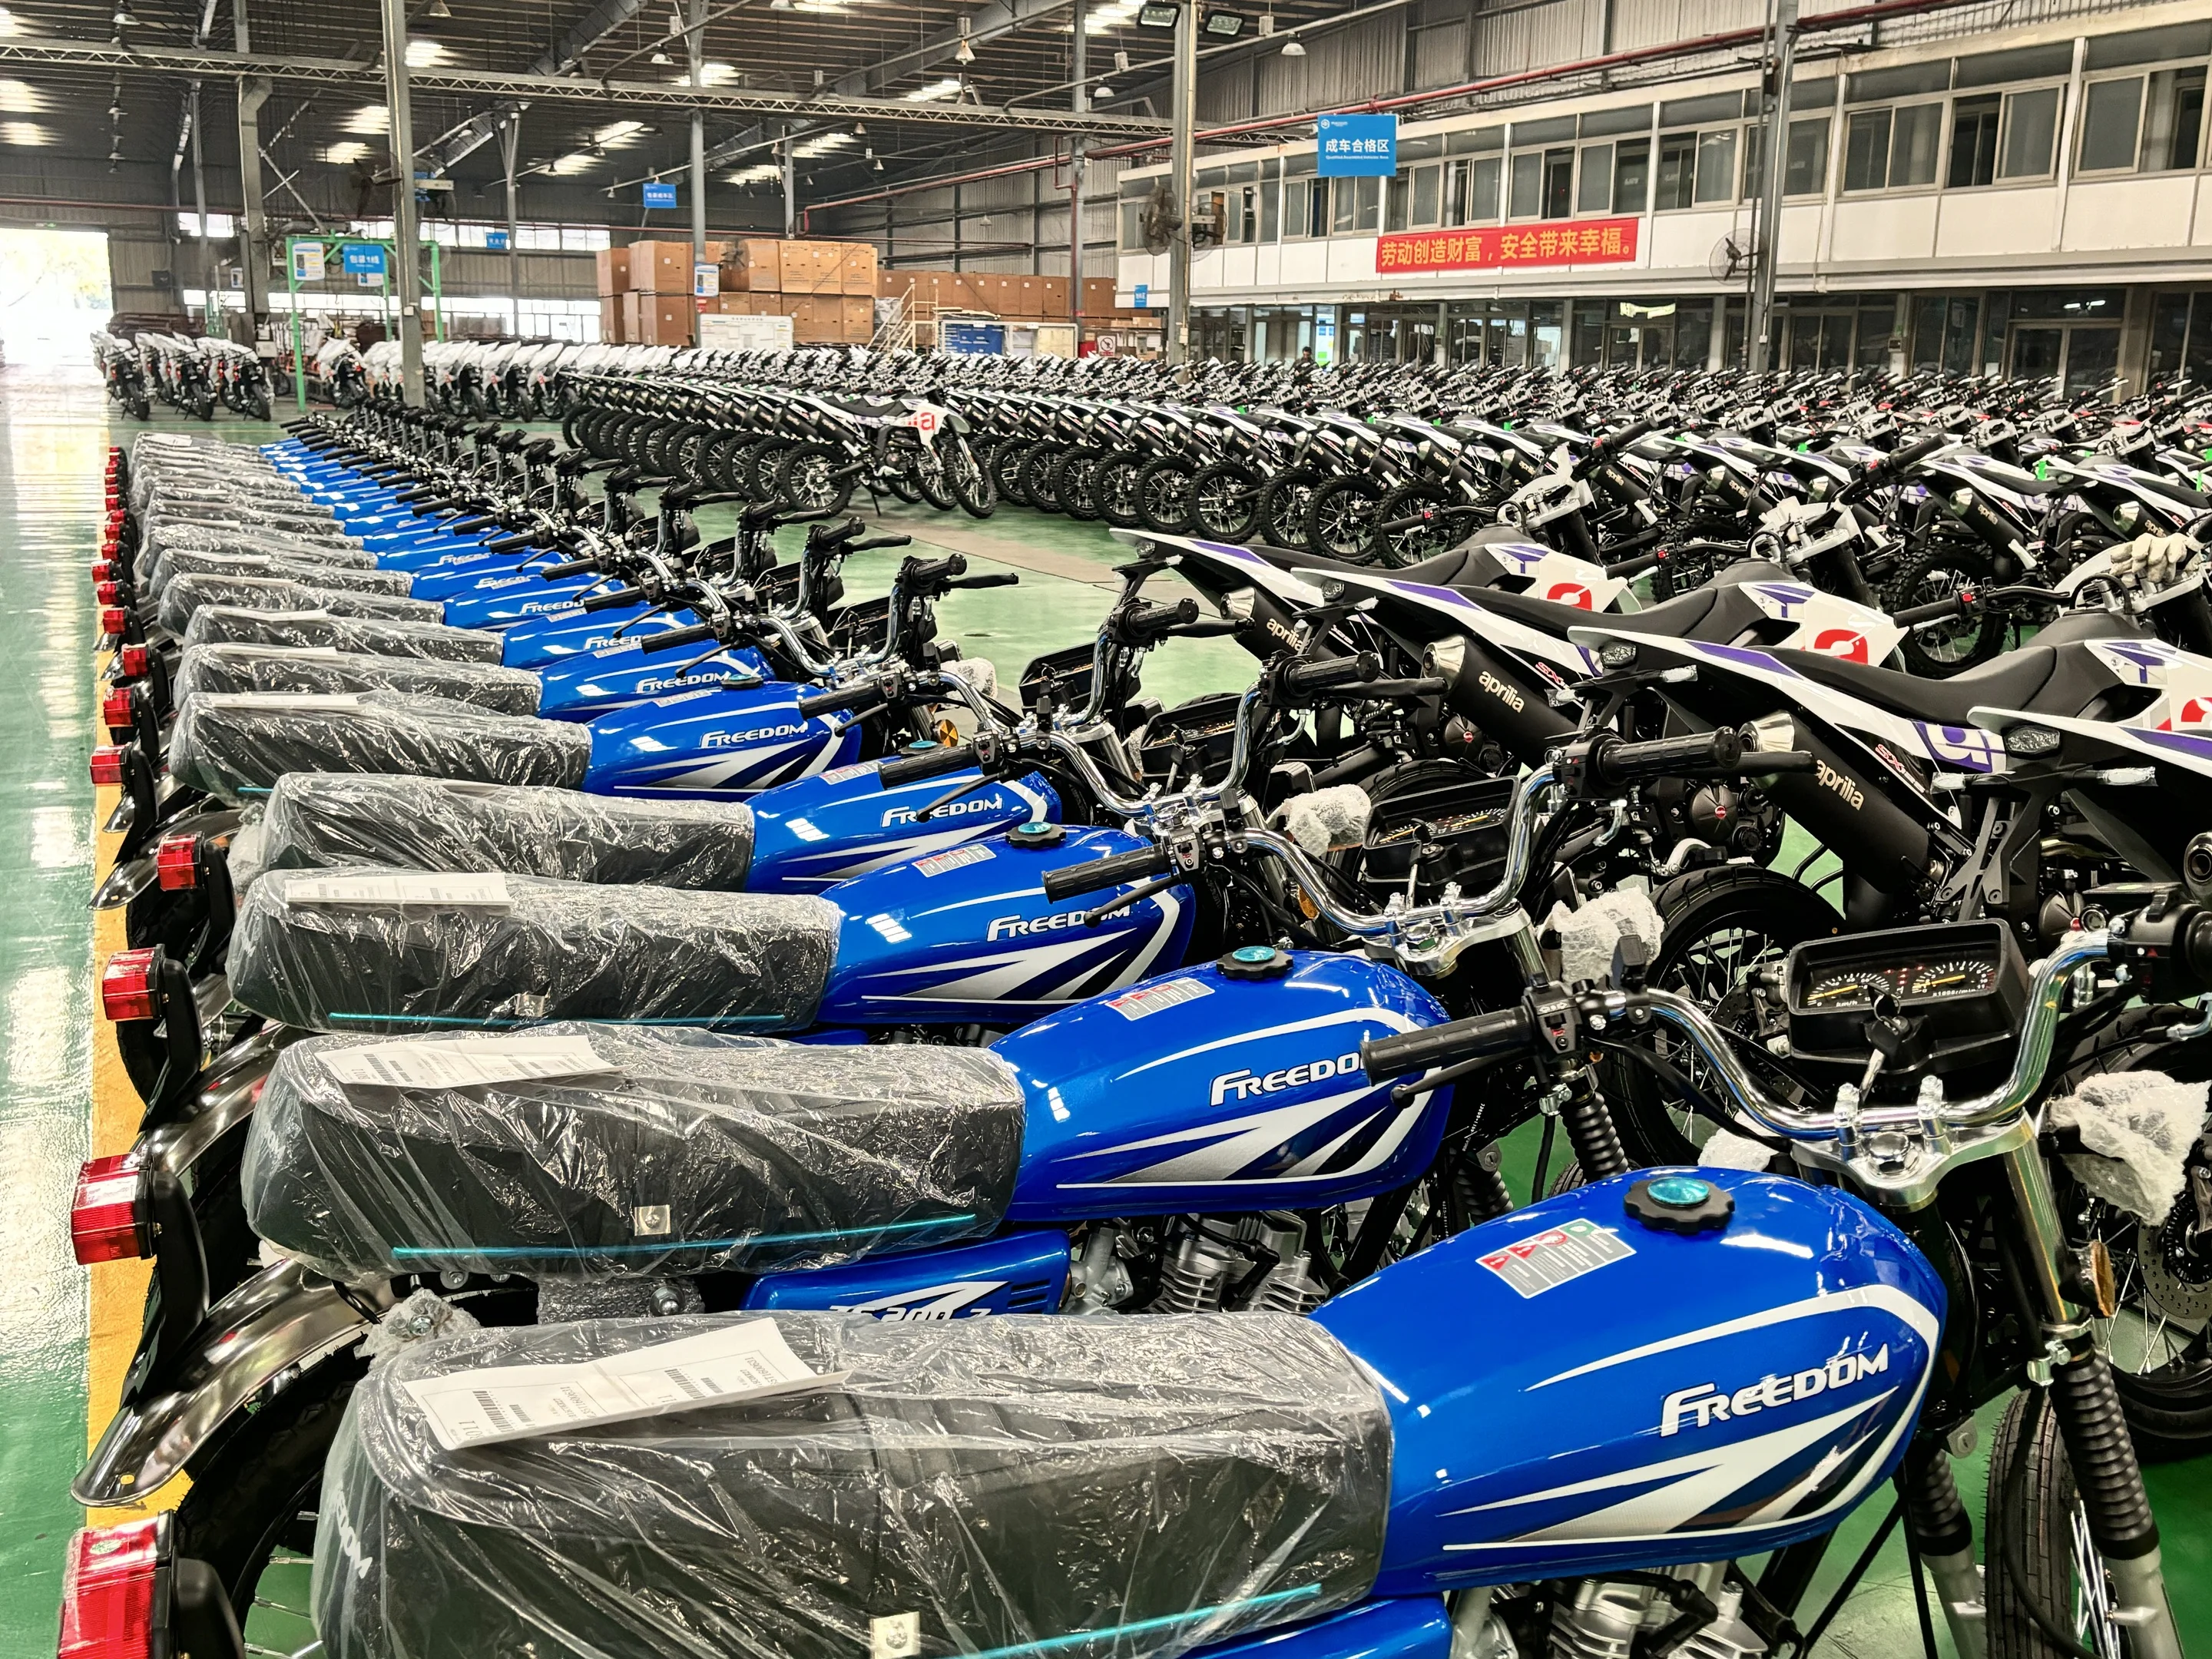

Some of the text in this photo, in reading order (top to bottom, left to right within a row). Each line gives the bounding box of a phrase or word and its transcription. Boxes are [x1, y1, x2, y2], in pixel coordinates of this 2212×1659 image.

[1326, 139, 1389, 153] 成车合格区
[1381, 227, 1629, 267] 劳动创造财富，安全带来幸福。
[1977, 504, 1998, 525] aprilia
[584, 635, 642, 651] FREED
[1267, 618, 1304, 651] aprilia
[636, 671, 730, 694] FREEDOM
[1478, 670, 1525, 714] aprilia
[700, 722, 808, 749] FREEDOM
[1816, 759, 1865, 811] aprilia
[1210, 1051, 1363, 1107] FREEDO
[1660, 1343, 1889, 1438] FREEDOM
